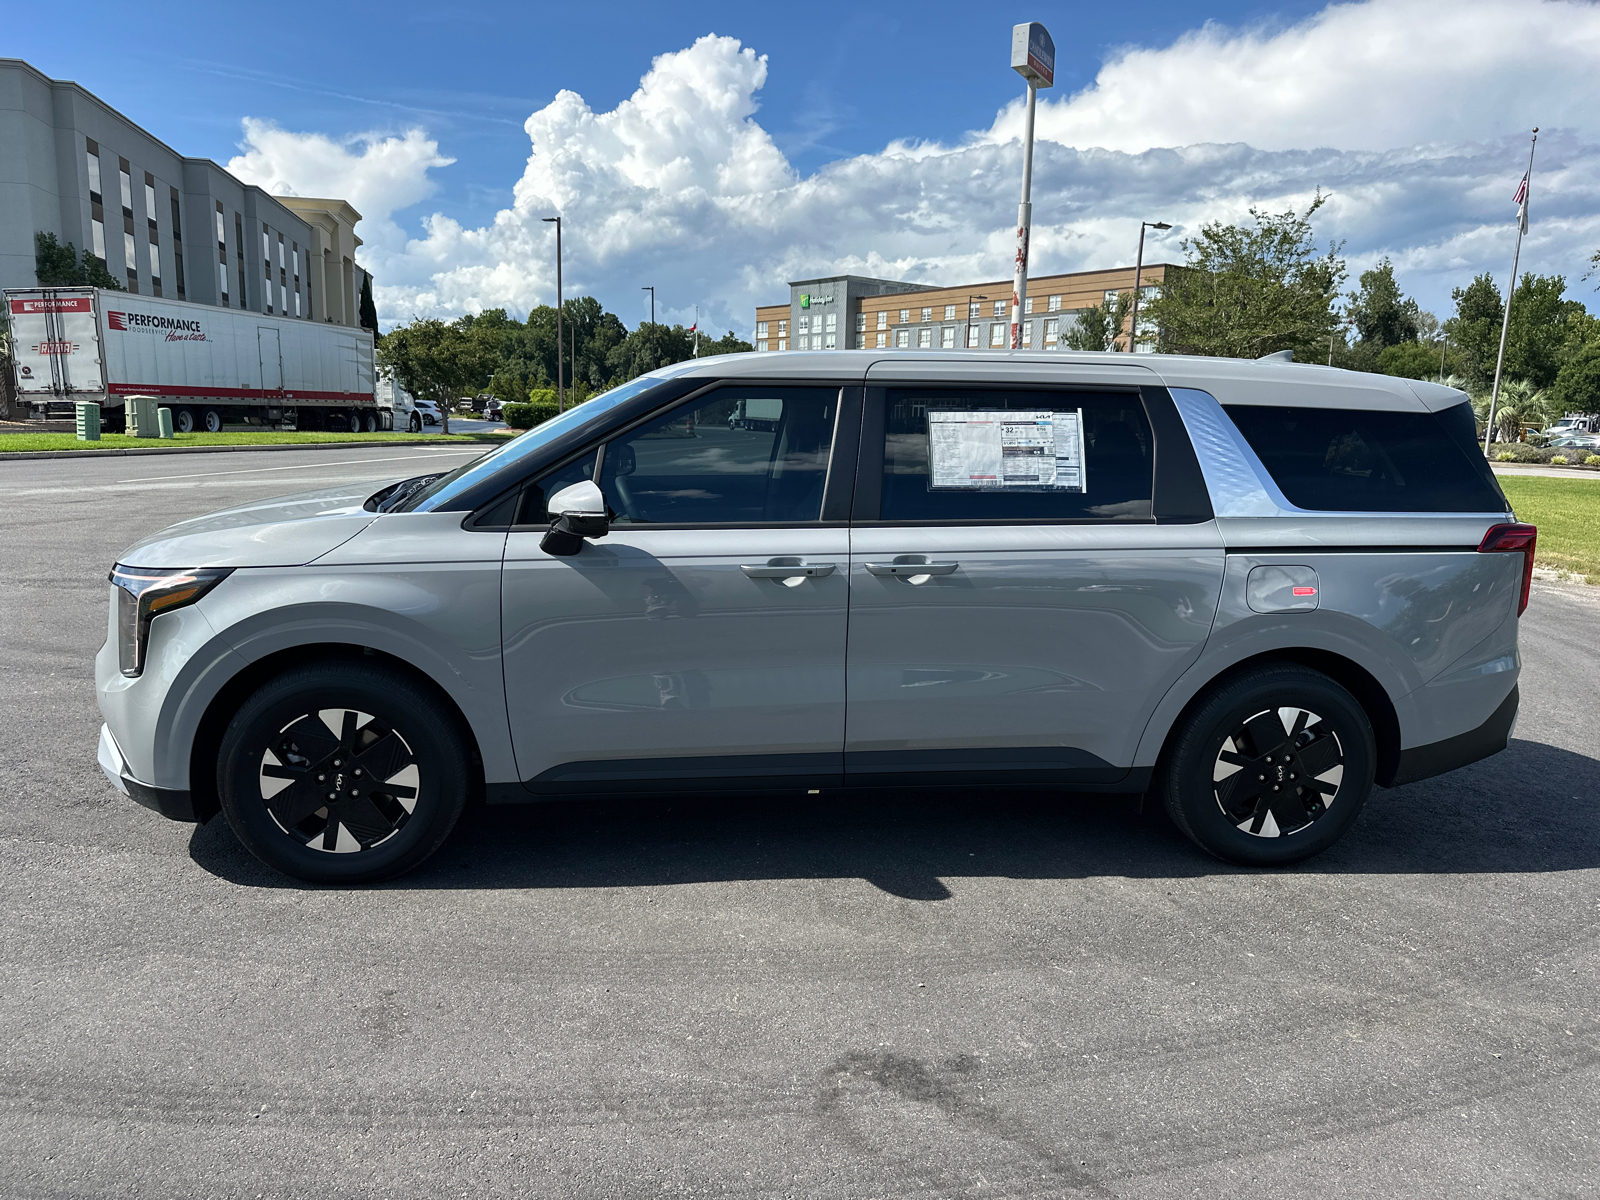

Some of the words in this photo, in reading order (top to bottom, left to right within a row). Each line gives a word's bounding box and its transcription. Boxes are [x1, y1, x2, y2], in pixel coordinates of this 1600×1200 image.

[810, 296, 825, 304] Holiday
[128, 313, 201, 332] PERFORMANCE
[128, 326, 167, 335] FOODSERVICE
[165, 330, 183, 342] Have
